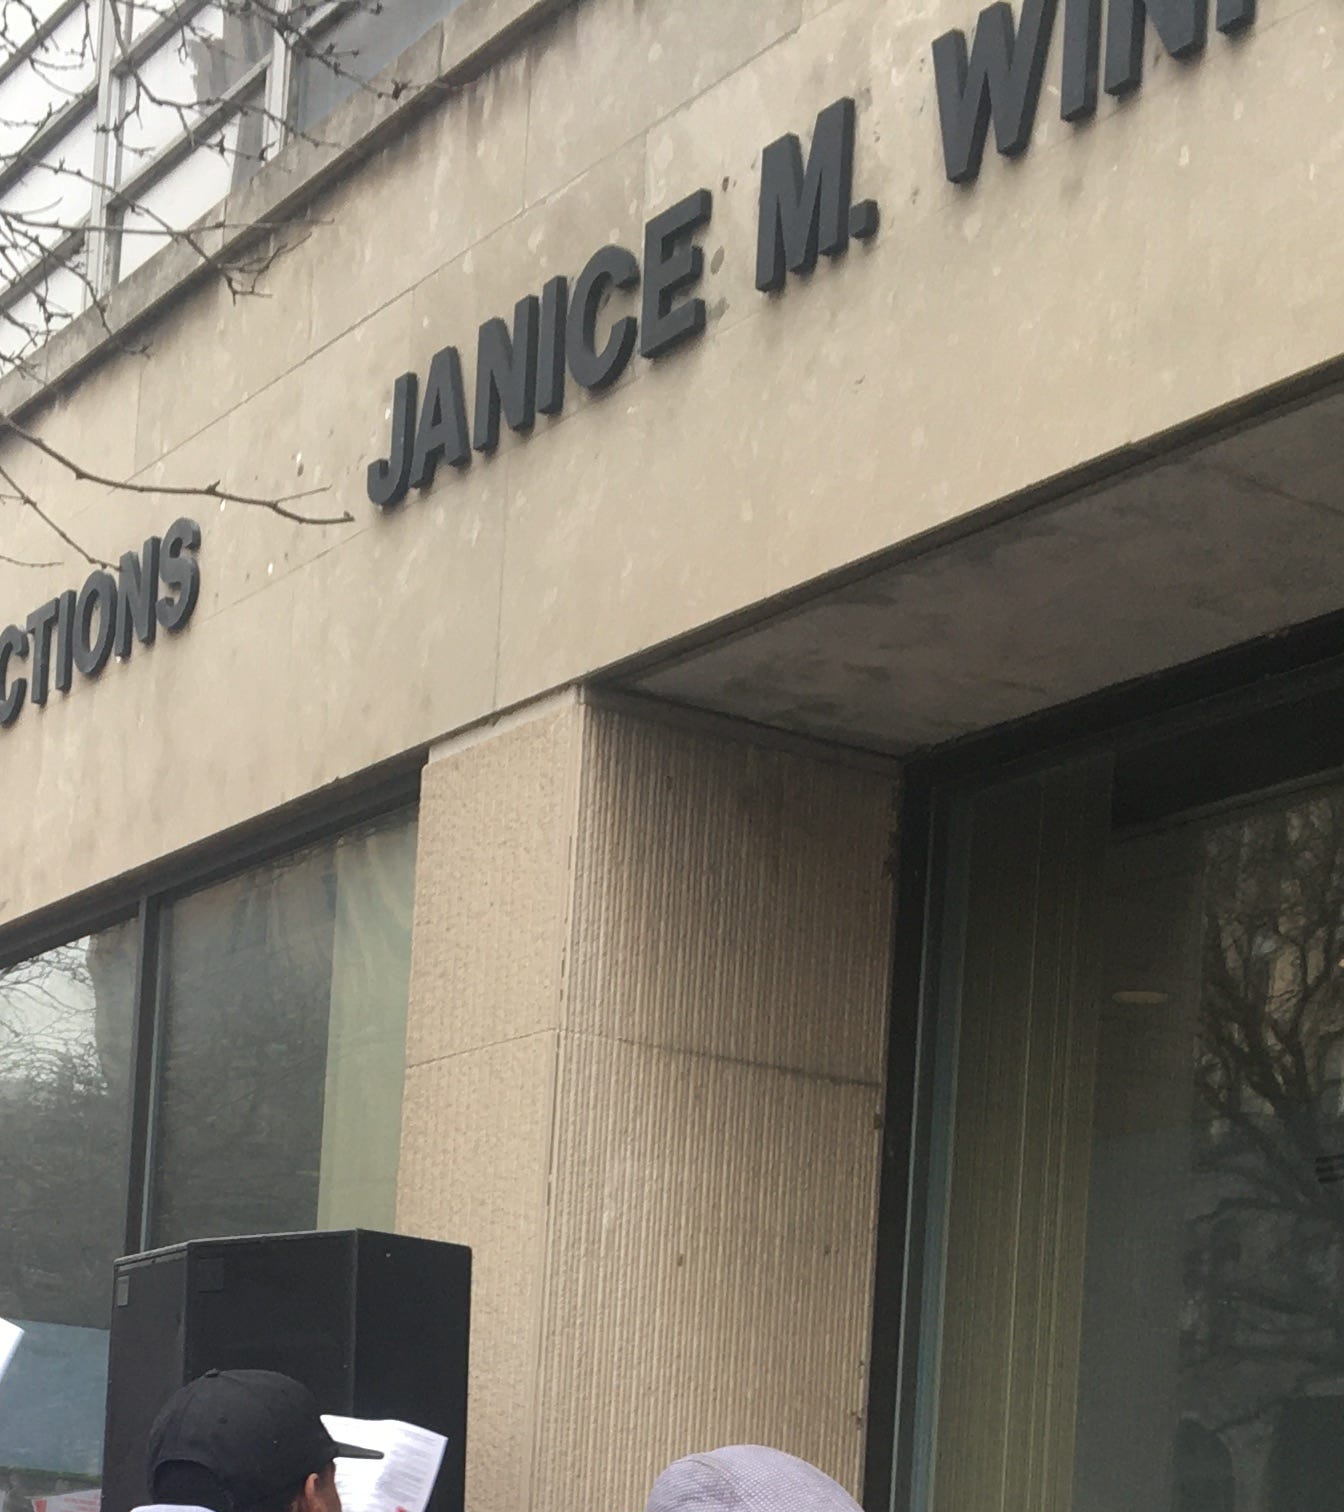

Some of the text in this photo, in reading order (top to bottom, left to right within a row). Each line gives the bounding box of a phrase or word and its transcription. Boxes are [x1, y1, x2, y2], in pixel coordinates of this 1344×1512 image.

[367, 0, 1256, 509] JANICE M. WIN
